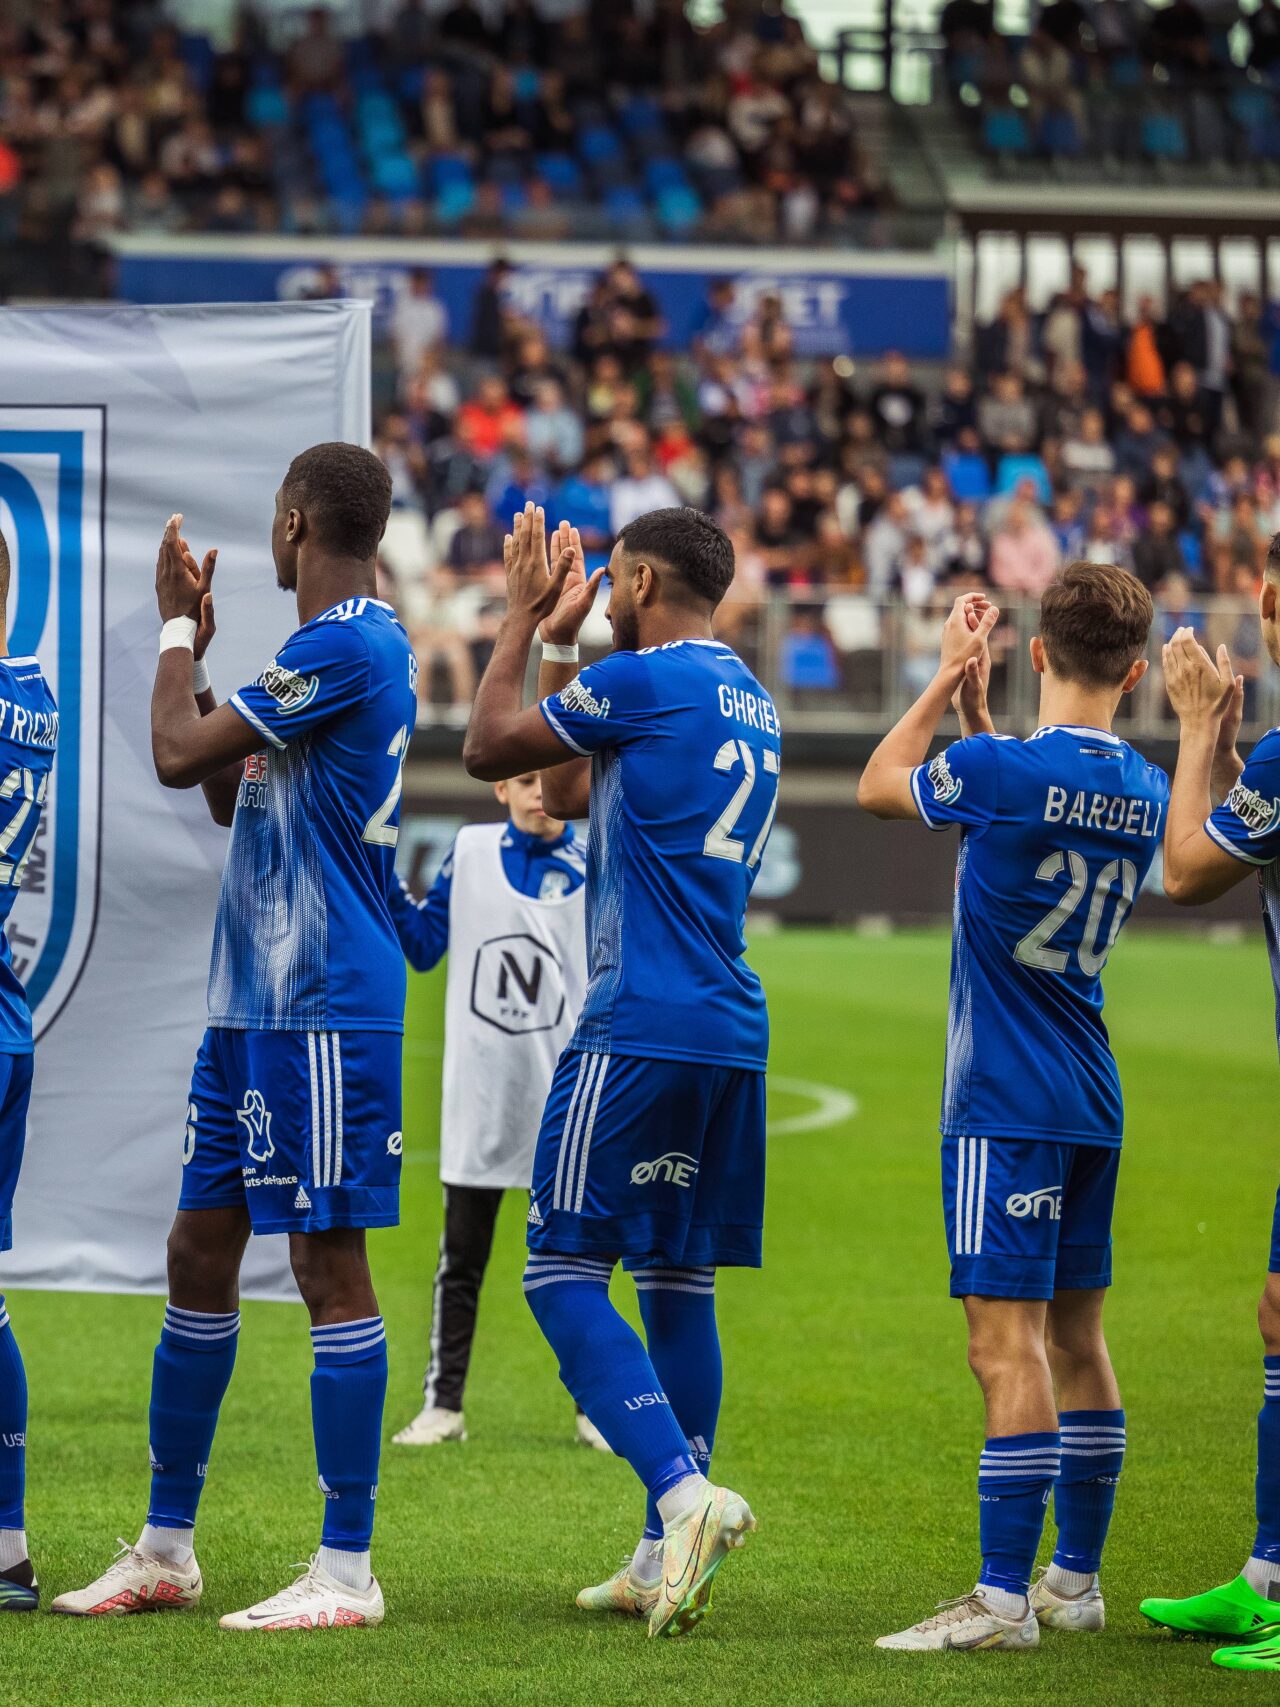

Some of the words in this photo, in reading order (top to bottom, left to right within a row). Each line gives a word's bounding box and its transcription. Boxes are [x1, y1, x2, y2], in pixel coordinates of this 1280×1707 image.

[237, 780, 269, 809] ORT
[361, 724, 411, 849] 2
[702, 738, 782, 868] 27
[1012, 850, 1138, 978] 20
[496, 949, 543, 1006] N
[2, 1432, 26, 1448] USL
